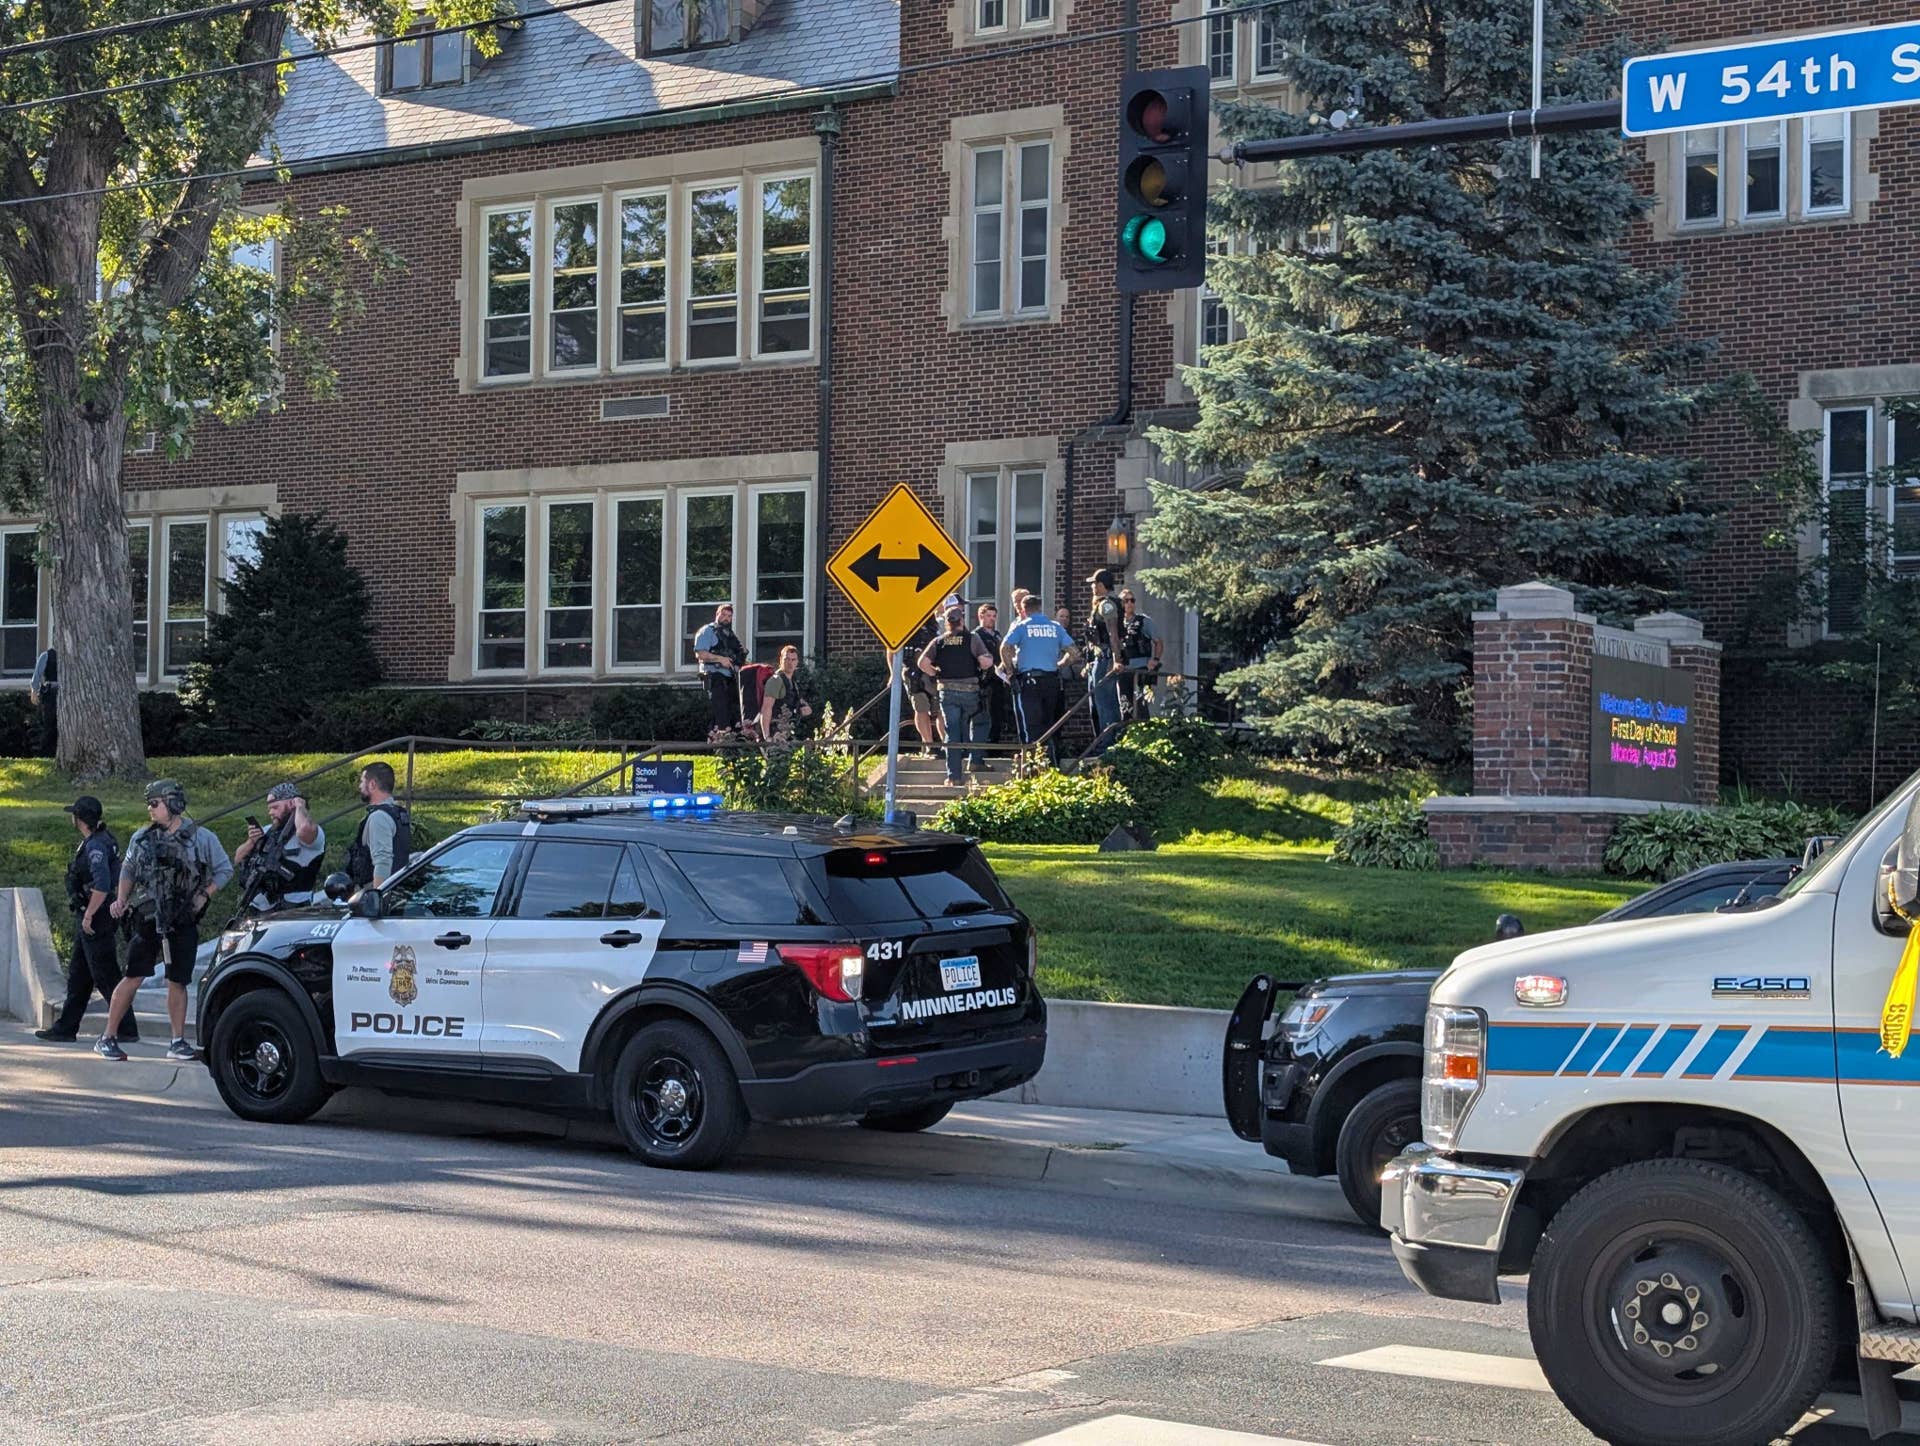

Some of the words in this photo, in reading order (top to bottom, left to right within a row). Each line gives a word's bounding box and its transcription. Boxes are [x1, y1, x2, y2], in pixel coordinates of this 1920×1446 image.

[1649, 72, 1687, 113] W
[1721, 53, 1856, 104] 54th
[1027, 628, 1058, 638] POLICE
[1600, 692, 1634, 716] Welcome
[1611, 717, 1629, 739] First
[1630, 719, 1645, 746] Day
[1645, 722, 1654, 742] of
[1653, 723, 1677, 746] School
[1643, 746, 1667, 771] August
[1667, 748, 1677, 769] 25
[635, 767, 657, 776] School
[310, 923, 340, 938] 431
[867, 941, 903, 960] 431
[944, 966, 979, 984] POLICE
[902, 987, 1016, 1020] MINNEAPOLIS
[351, 1012, 465, 1038] POLICE
